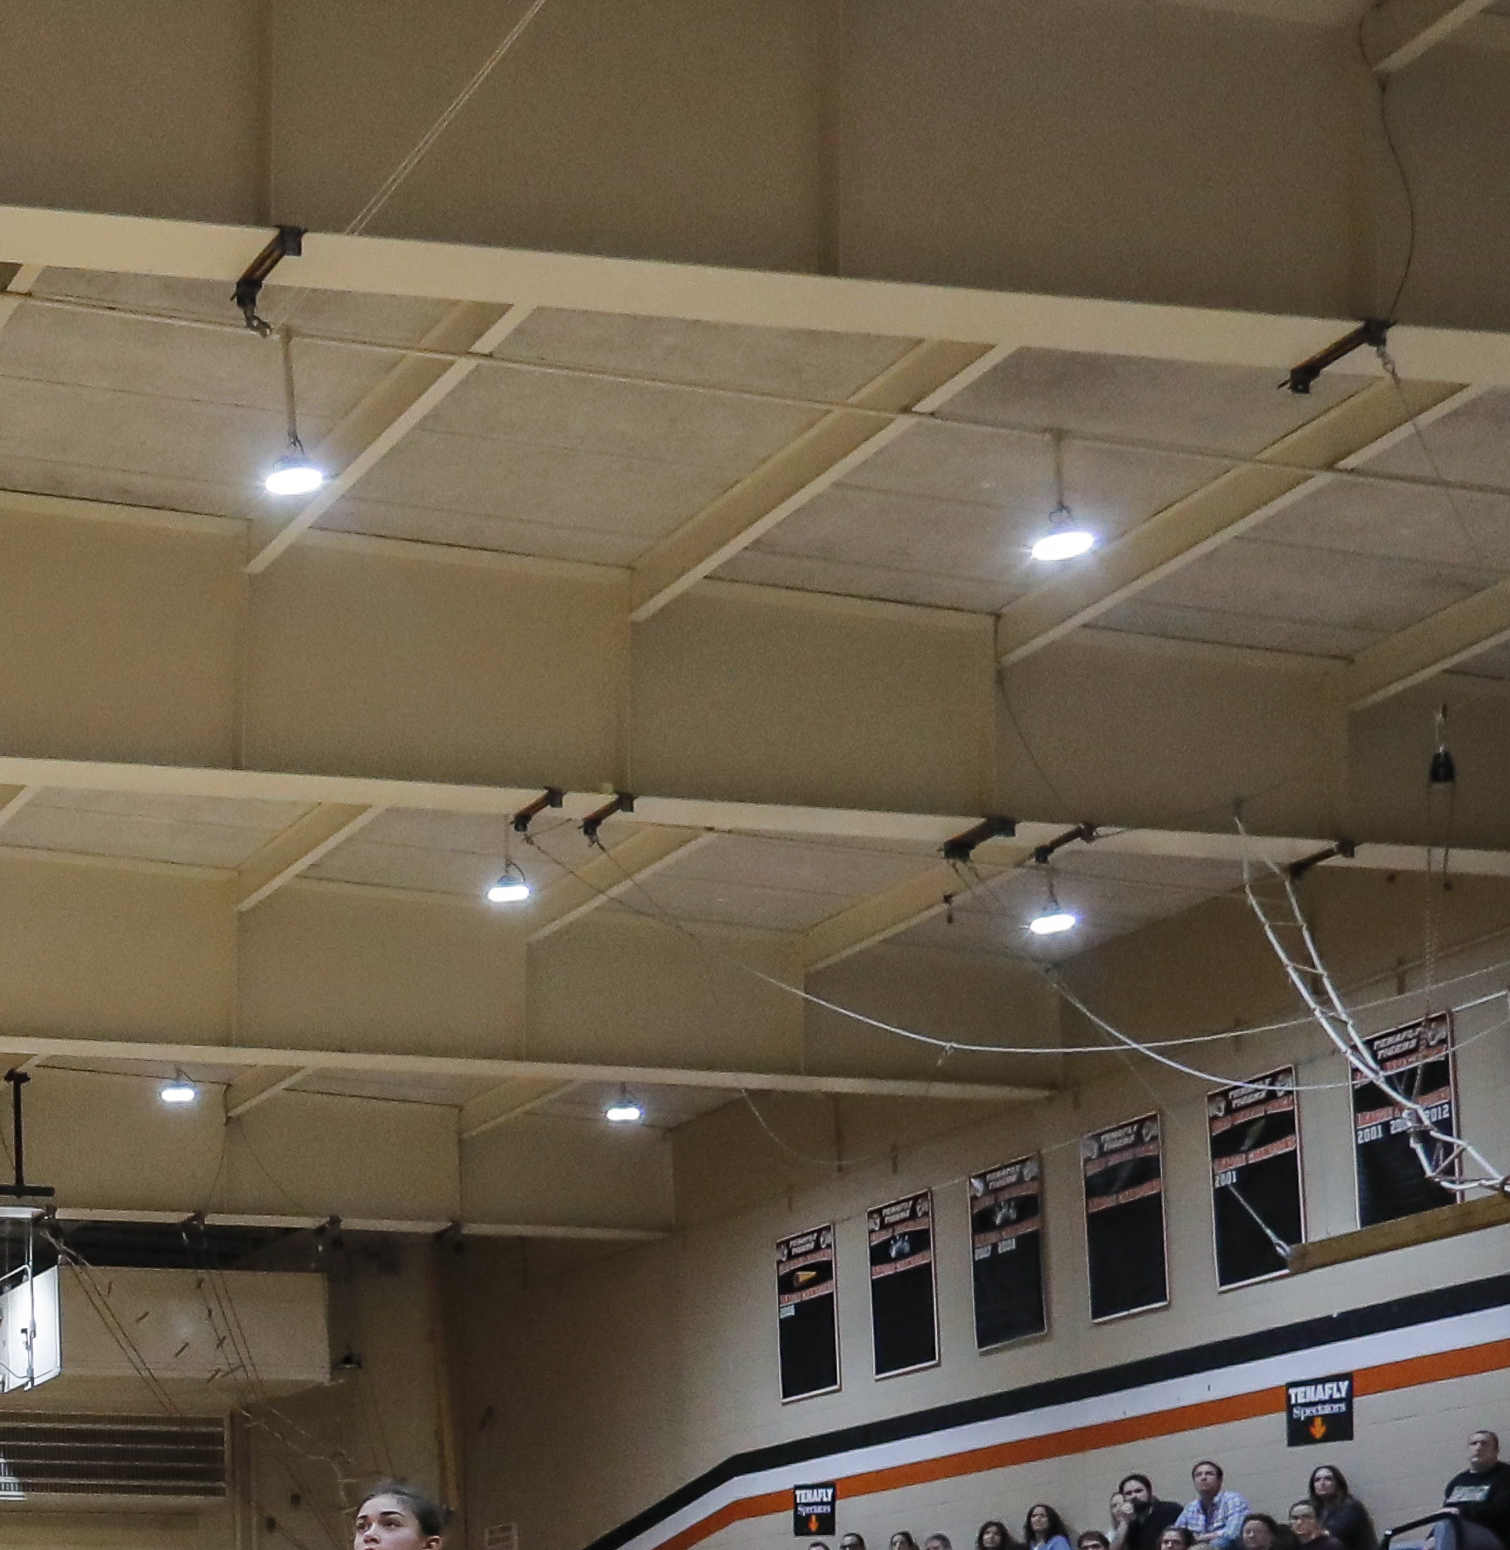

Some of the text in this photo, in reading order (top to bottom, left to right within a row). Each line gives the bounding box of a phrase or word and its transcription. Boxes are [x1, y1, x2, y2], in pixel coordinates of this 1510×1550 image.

[1288, 1380, 1349, 1404] TENAFLY
[1292, 1402, 1346, 1421] Spectators
[795, 1488, 833, 1503] TENAFLY
